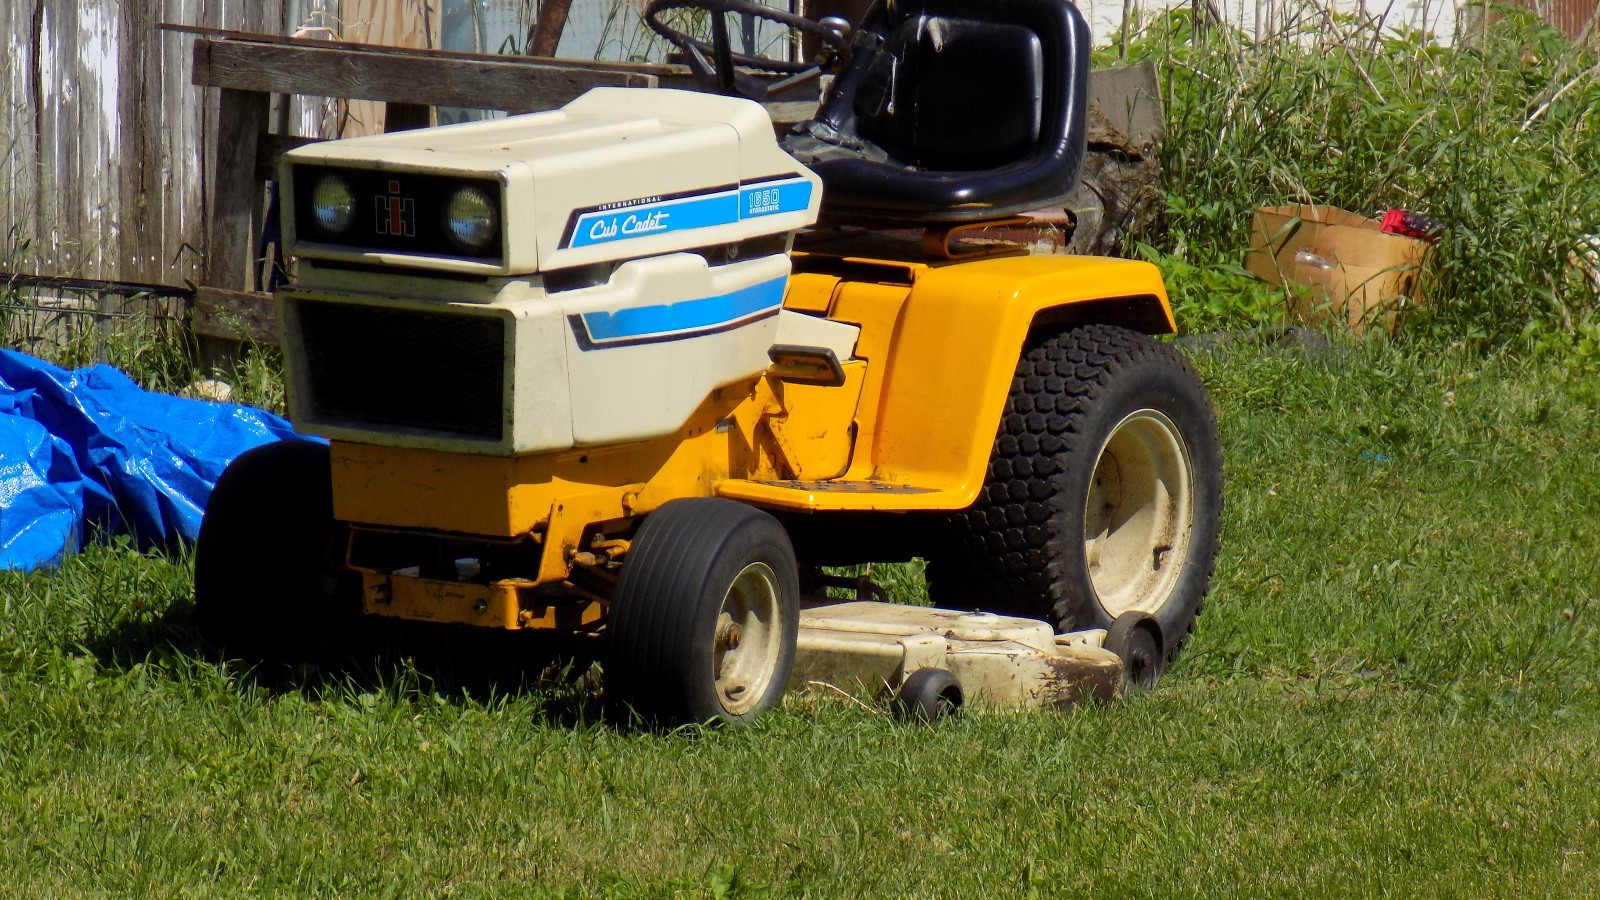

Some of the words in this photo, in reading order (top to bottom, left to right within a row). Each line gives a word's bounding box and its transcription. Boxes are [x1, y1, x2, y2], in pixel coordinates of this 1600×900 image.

[598, 196, 661, 211] INTERNATIONAL
[749, 188, 779, 208] 1650
[749, 204, 779, 214] HYDROSTATIC
[589, 218, 618, 239] Cub
[621, 211, 670, 235] Cadet
